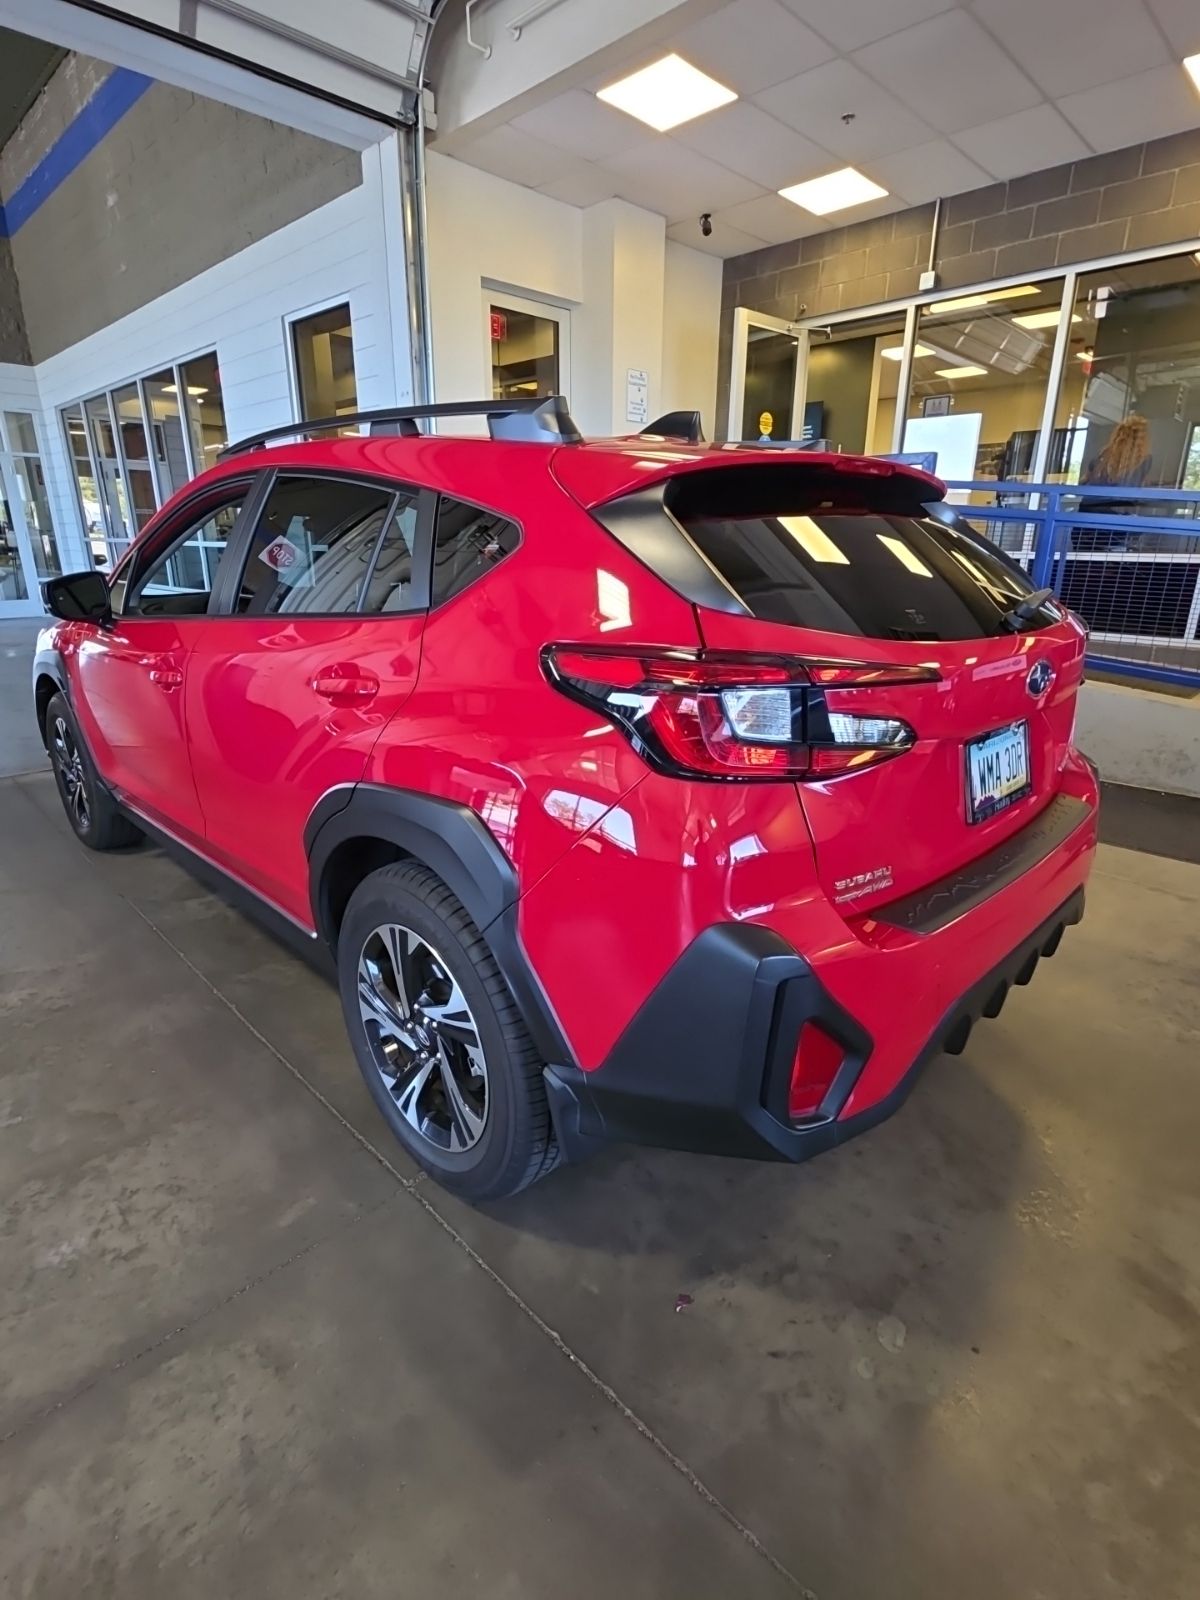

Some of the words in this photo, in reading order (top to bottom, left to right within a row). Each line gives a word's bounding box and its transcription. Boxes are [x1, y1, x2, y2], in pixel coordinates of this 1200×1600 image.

[977, 752, 1002, 795] WMA
[1004, 741, 1023, 783] 3DR
[834, 866, 892, 890] SUBARU
